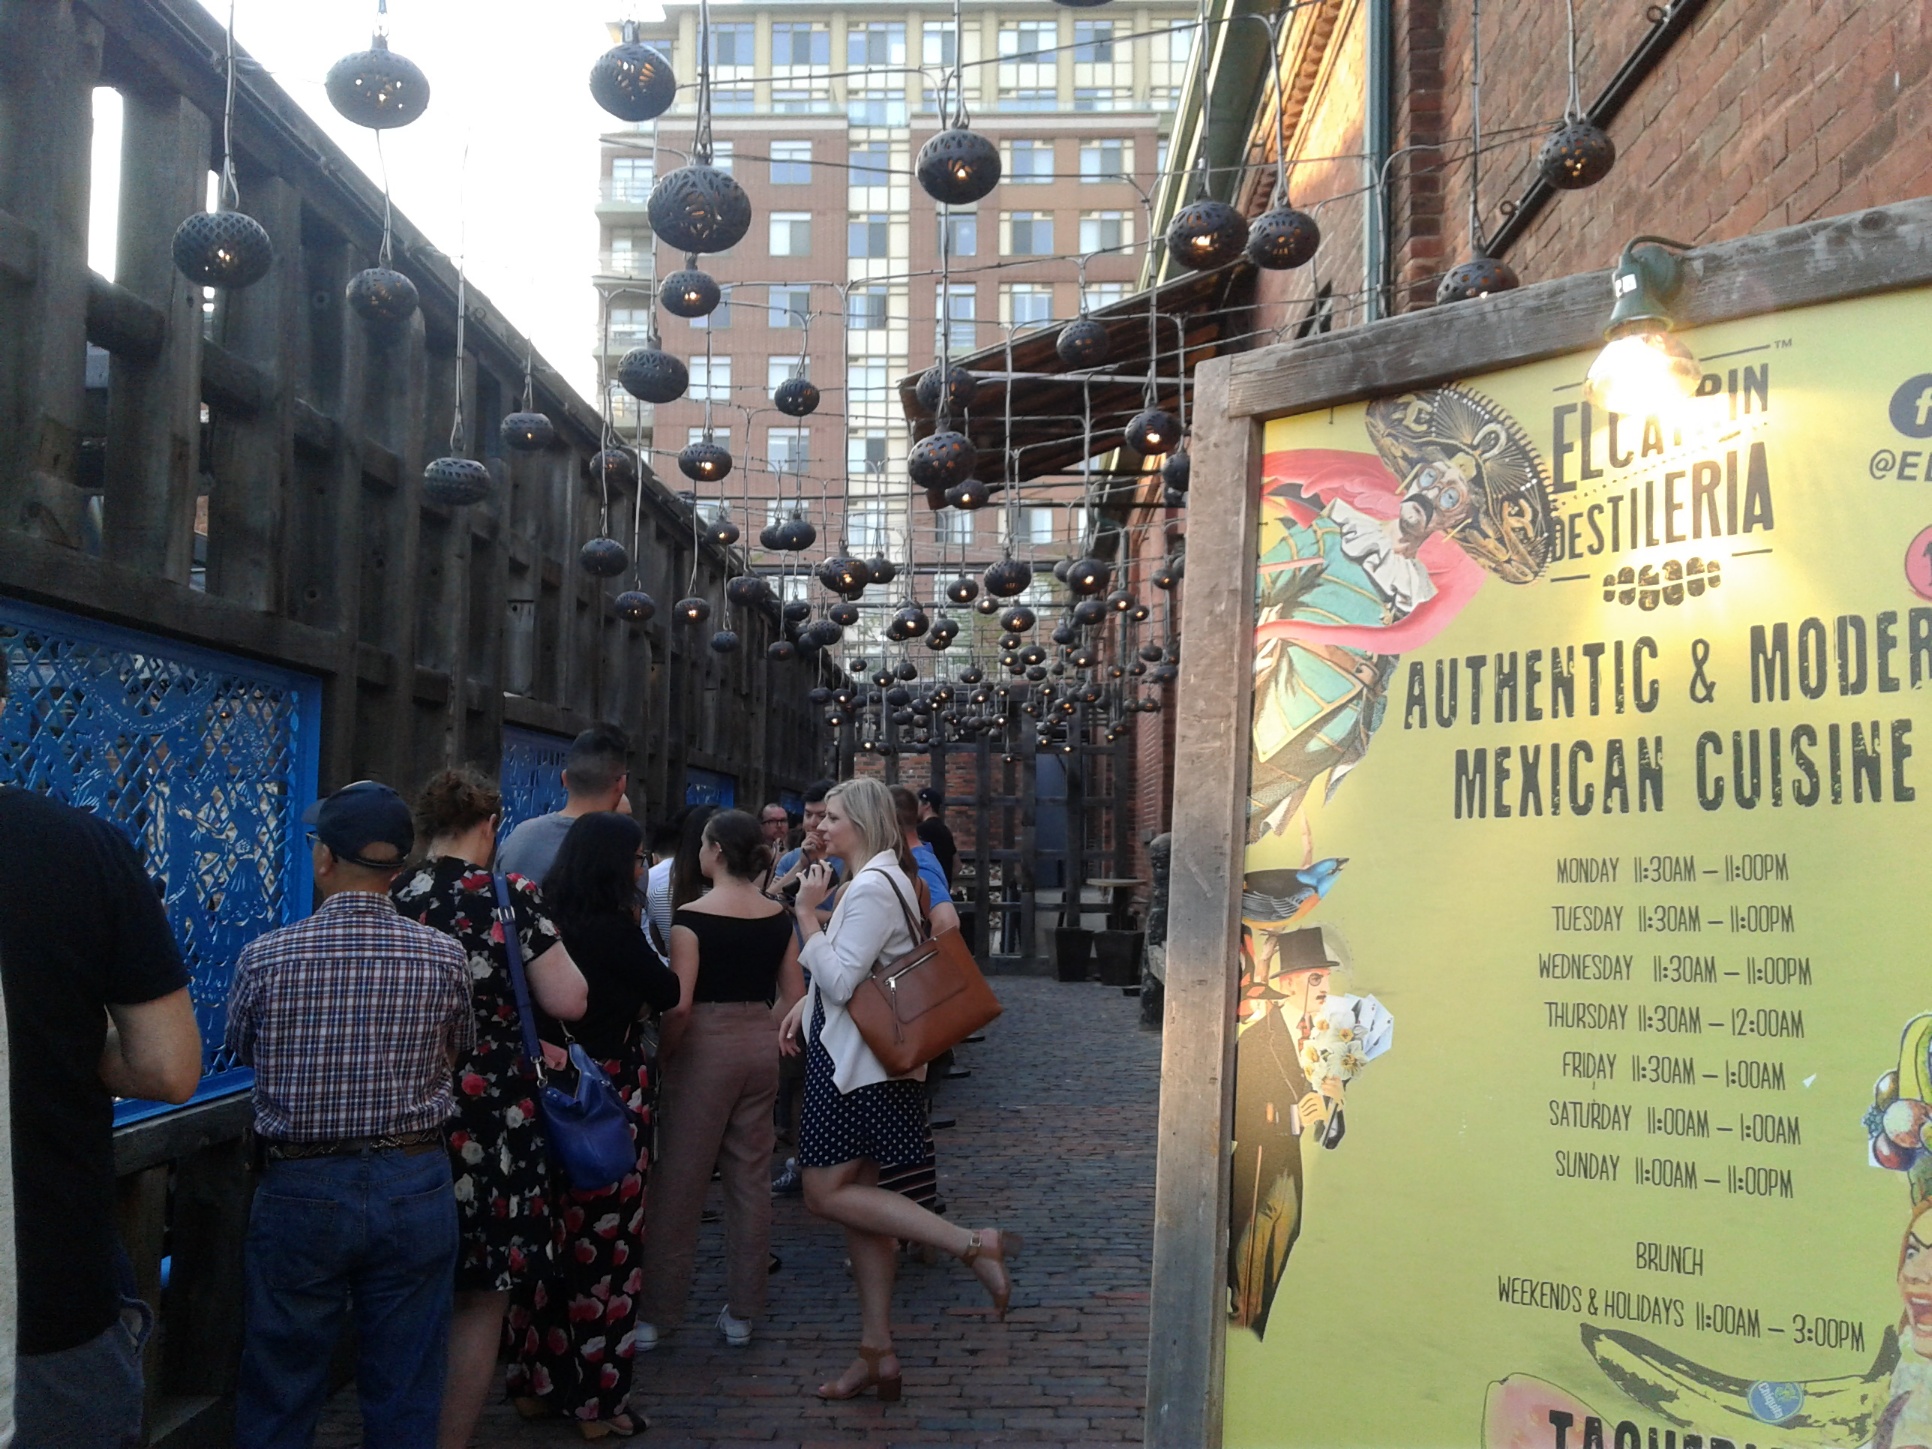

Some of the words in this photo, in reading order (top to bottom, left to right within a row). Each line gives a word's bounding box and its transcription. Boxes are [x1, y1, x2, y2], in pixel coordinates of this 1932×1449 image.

[1403, 635, 1660, 730] AUTHENTIC
[1689, 637, 1717, 704] &
[1453, 735, 1665, 819] MEXICAN
[1696, 718, 1917, 812] CUISINE
[1556, 857, 1620, 884] MONDAY
[1634, 855, 1697, 883] 11:30AM
[1725, 853, 1790, 883] 11:00PM
[1551, 905, 1624, 932] TUESDAY
[1638, 905, 1702, 932] 11:30AM
[1730, 905, 1796, 933] 11:00PM
[1539, 952, 1634, 981] WEDNESDAY
[1653, 955, 1718, 984] 11:30AM
[1747, 956, 1813, 986] 11:00PM
[1543, 1001, 1629, 1031] THURSDAY
[1638, 1005, 1702, 1034] 11:30AM
[1731, 1008, 1805, 1039] 12:00AM
[1562, 1051, 1617, 1080] FRIDAY
[1632, 1055, 1696, 1085] 11:30AM
[1725, 1059, 1786, 1091] 1:00AM
[1549, 1100, 1632, 1132] SATURDAY
[1647, 1106, 1710, 1138] 11:00AM
[1740, 1113, 1802, 1145] 1:00AM
[1555, 1150, 1620, 1181] SUNDAY
[1635, 1156, 1698, 1190] 11:00AM
[1728, 1165, 1794, 1199] 11:00PM
[1636, 1241, 1704, 1277] BRUNCH
[1498, 1275, 1583, 1313] WEEKENDS
[1588, 1288, 1599, 1316] &
[1604, 1290, 1685, 1328] HOLIDAYS
[1696, 1301, 1761, 1338] 11:00AM
[1793, 1314, 1865, 1352] 3:00PM
[1758, 1382, 1784, 1419] Chiquita
